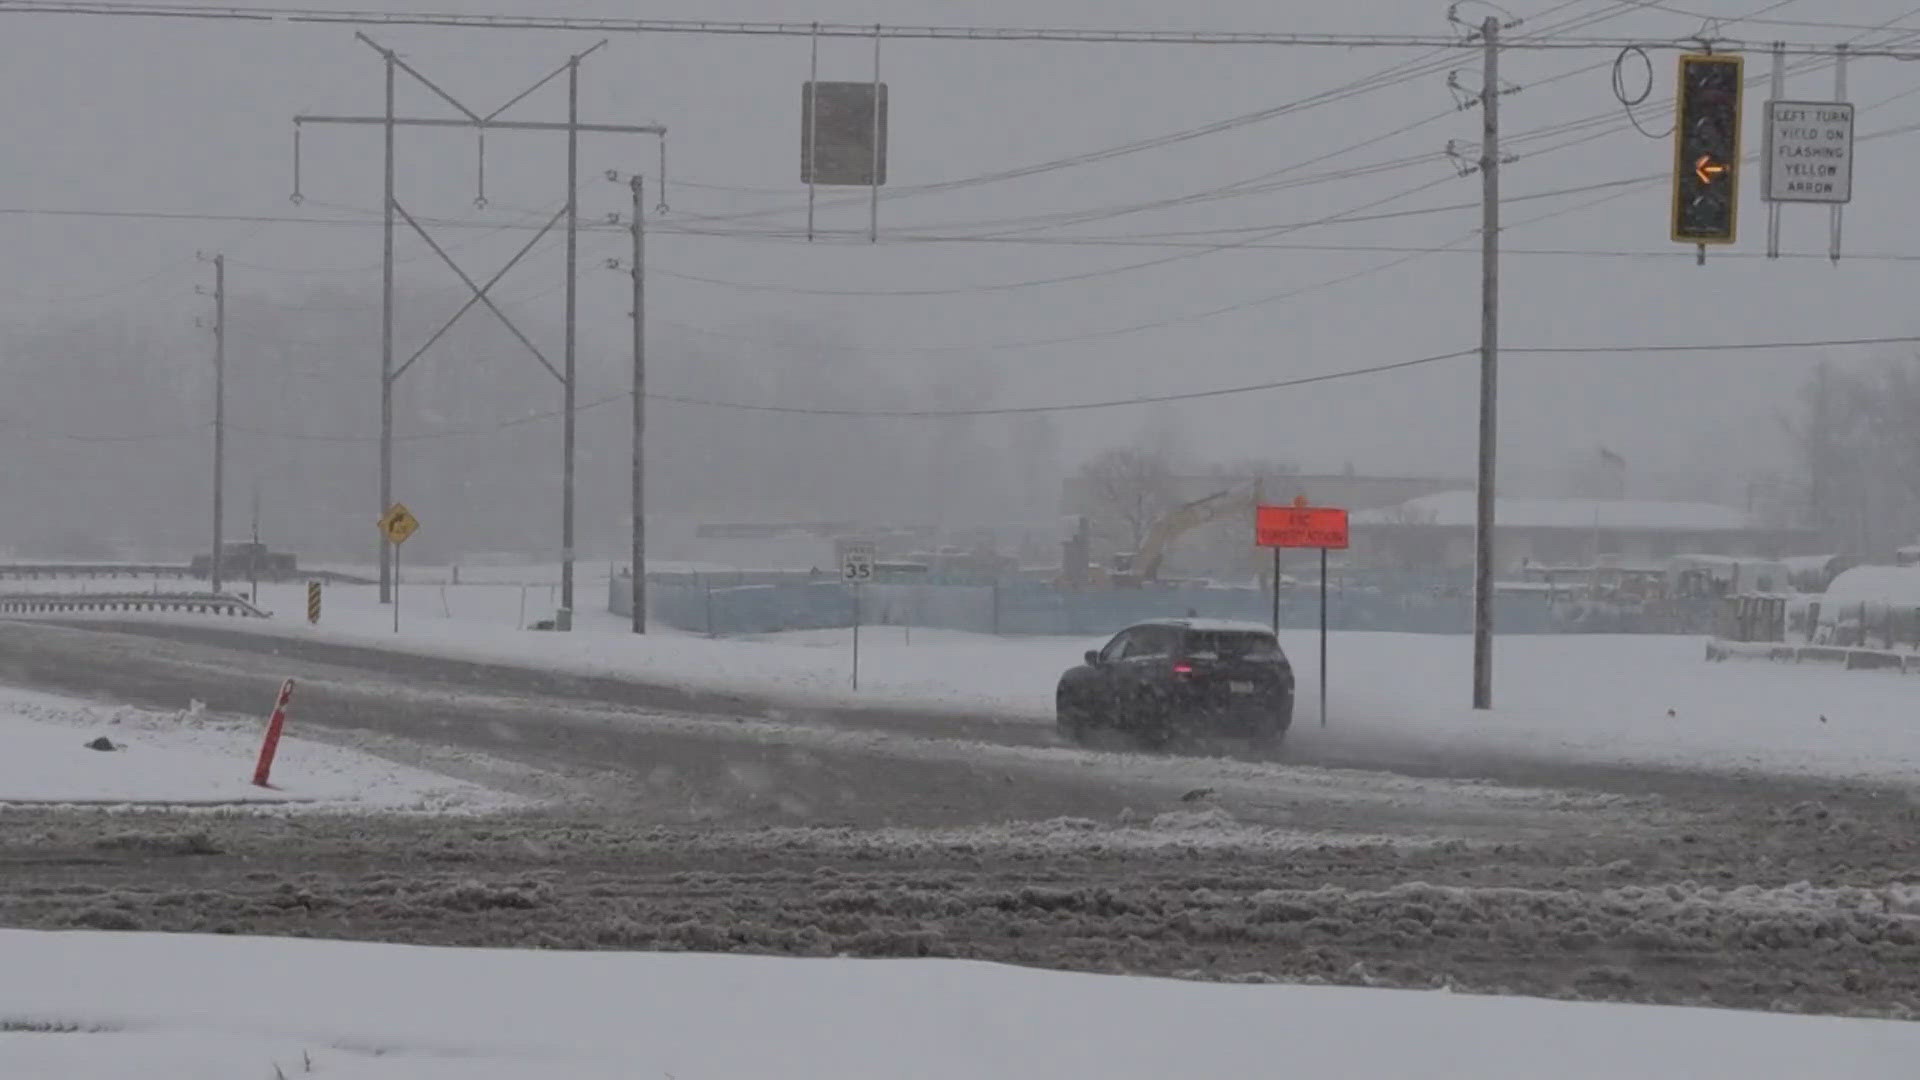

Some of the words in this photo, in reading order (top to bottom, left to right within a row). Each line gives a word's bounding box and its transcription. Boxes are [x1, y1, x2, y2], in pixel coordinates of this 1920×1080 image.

[1776, 110, 1806, 121] LEFT
[1816, 111, 1849, 122] TURN
[1780, 128, 1818, 140] YIELD
[1826, 129, 1844, 140] ON
[1785, 163, 1836, 176] YELLOW
[846, 563, 870, 579] 35
